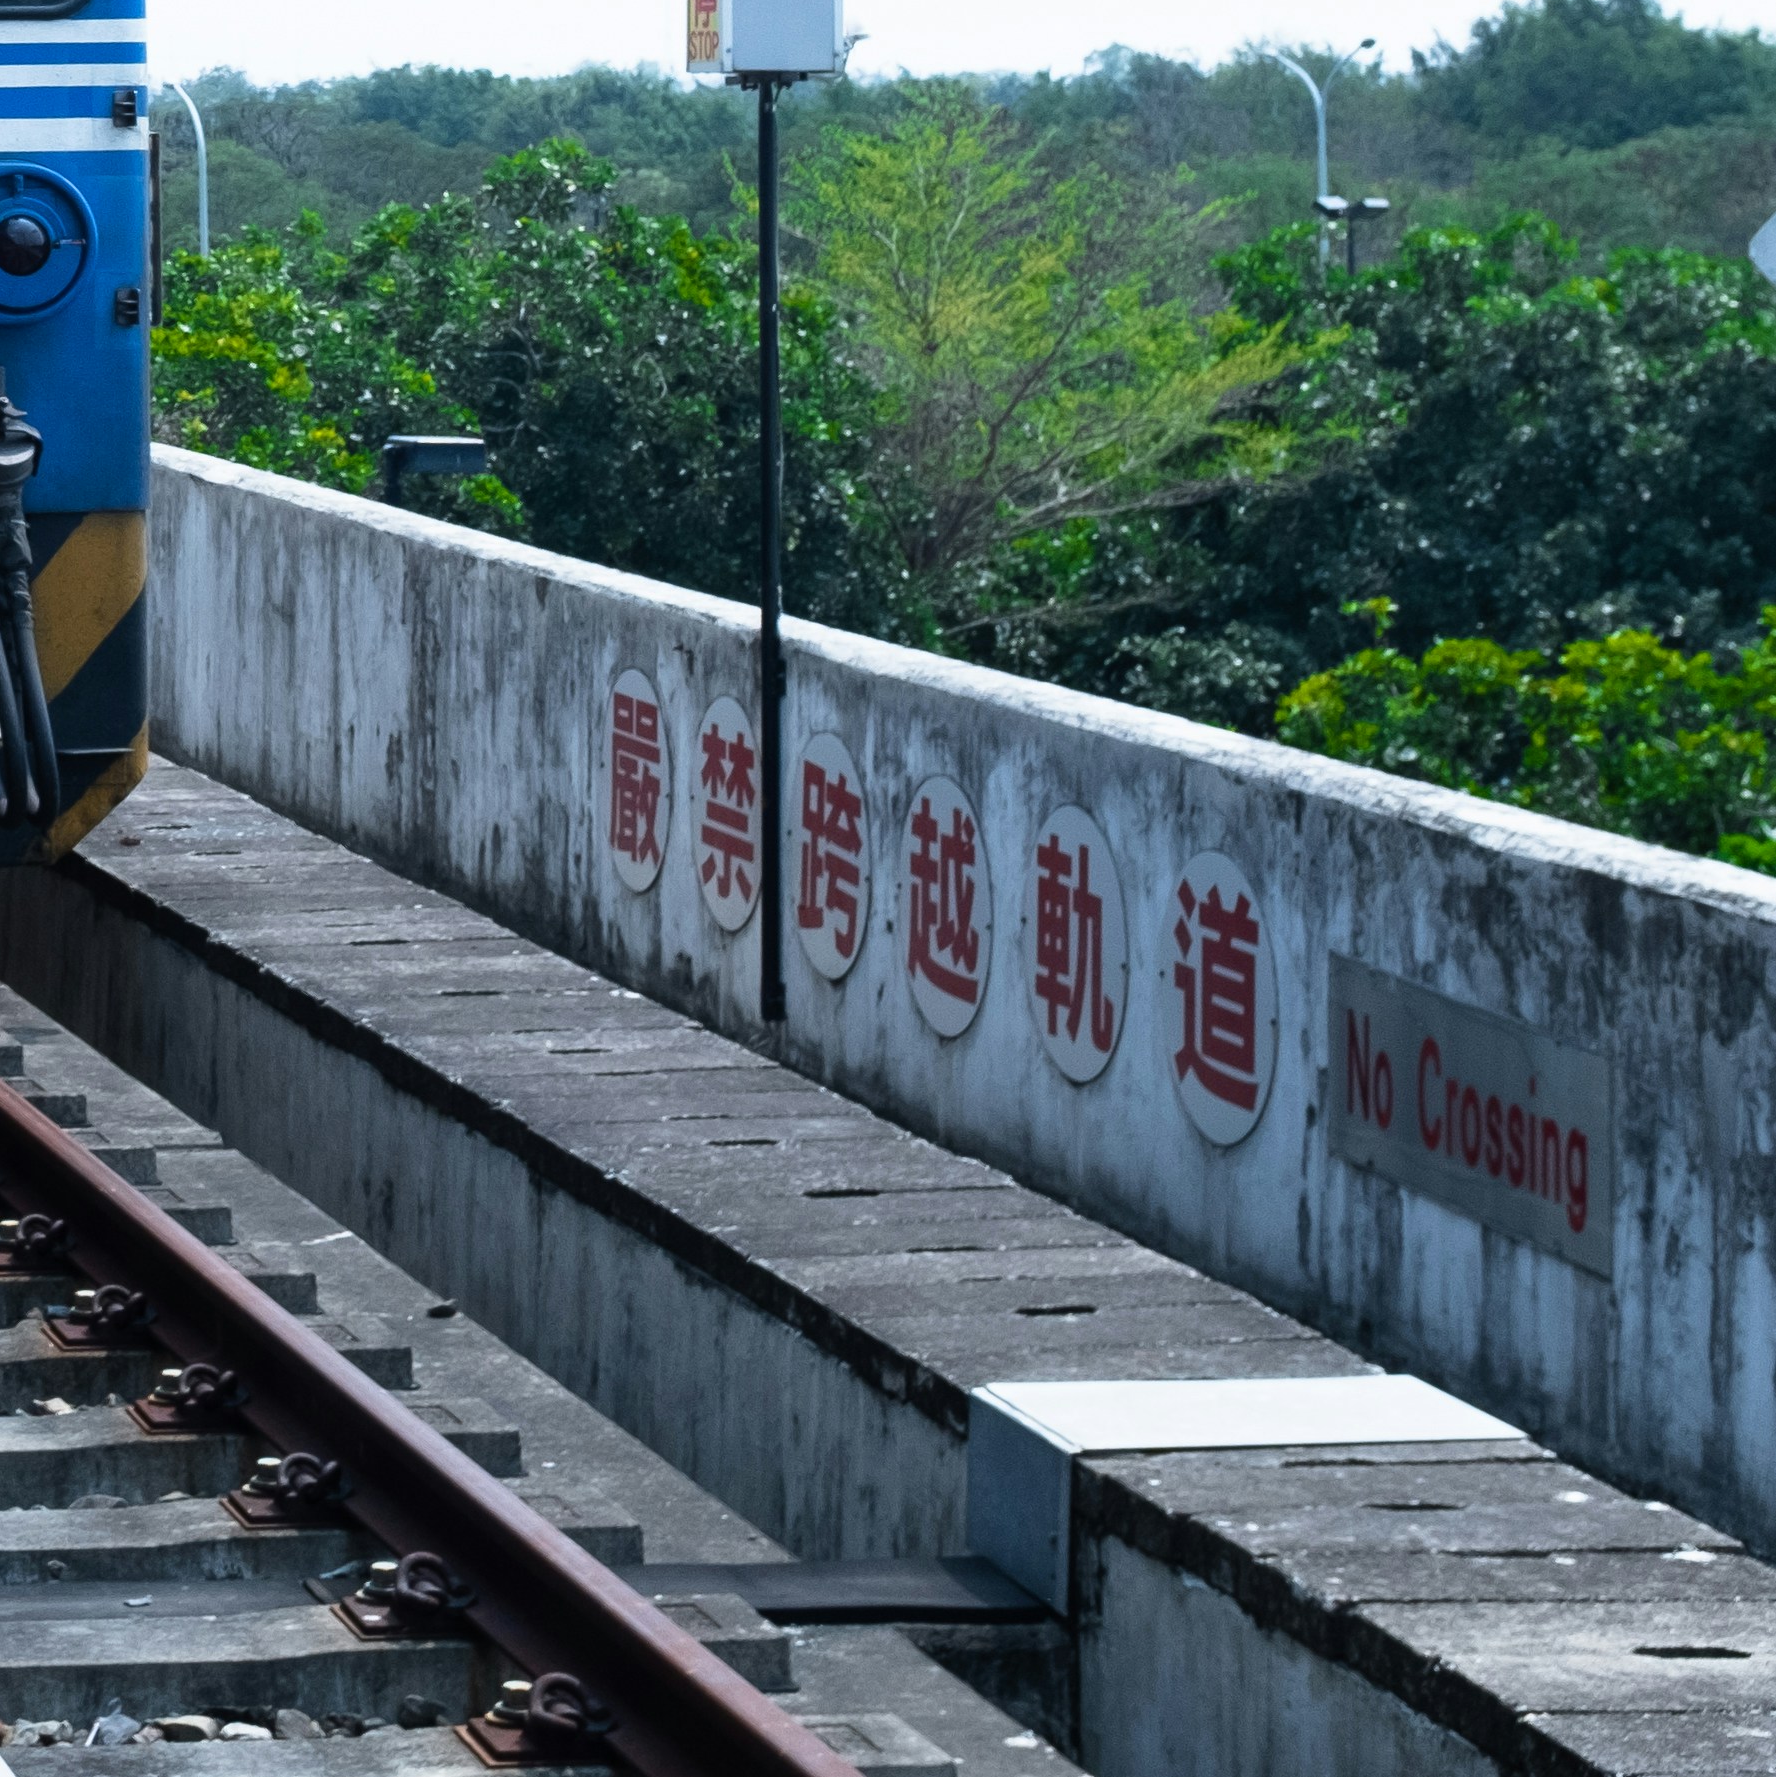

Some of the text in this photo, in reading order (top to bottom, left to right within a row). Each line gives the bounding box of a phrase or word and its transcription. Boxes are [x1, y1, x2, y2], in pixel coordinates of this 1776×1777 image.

[689, 30, 720, 61] STOP
[1347, 1008, 1589, 1234] No Crossing
